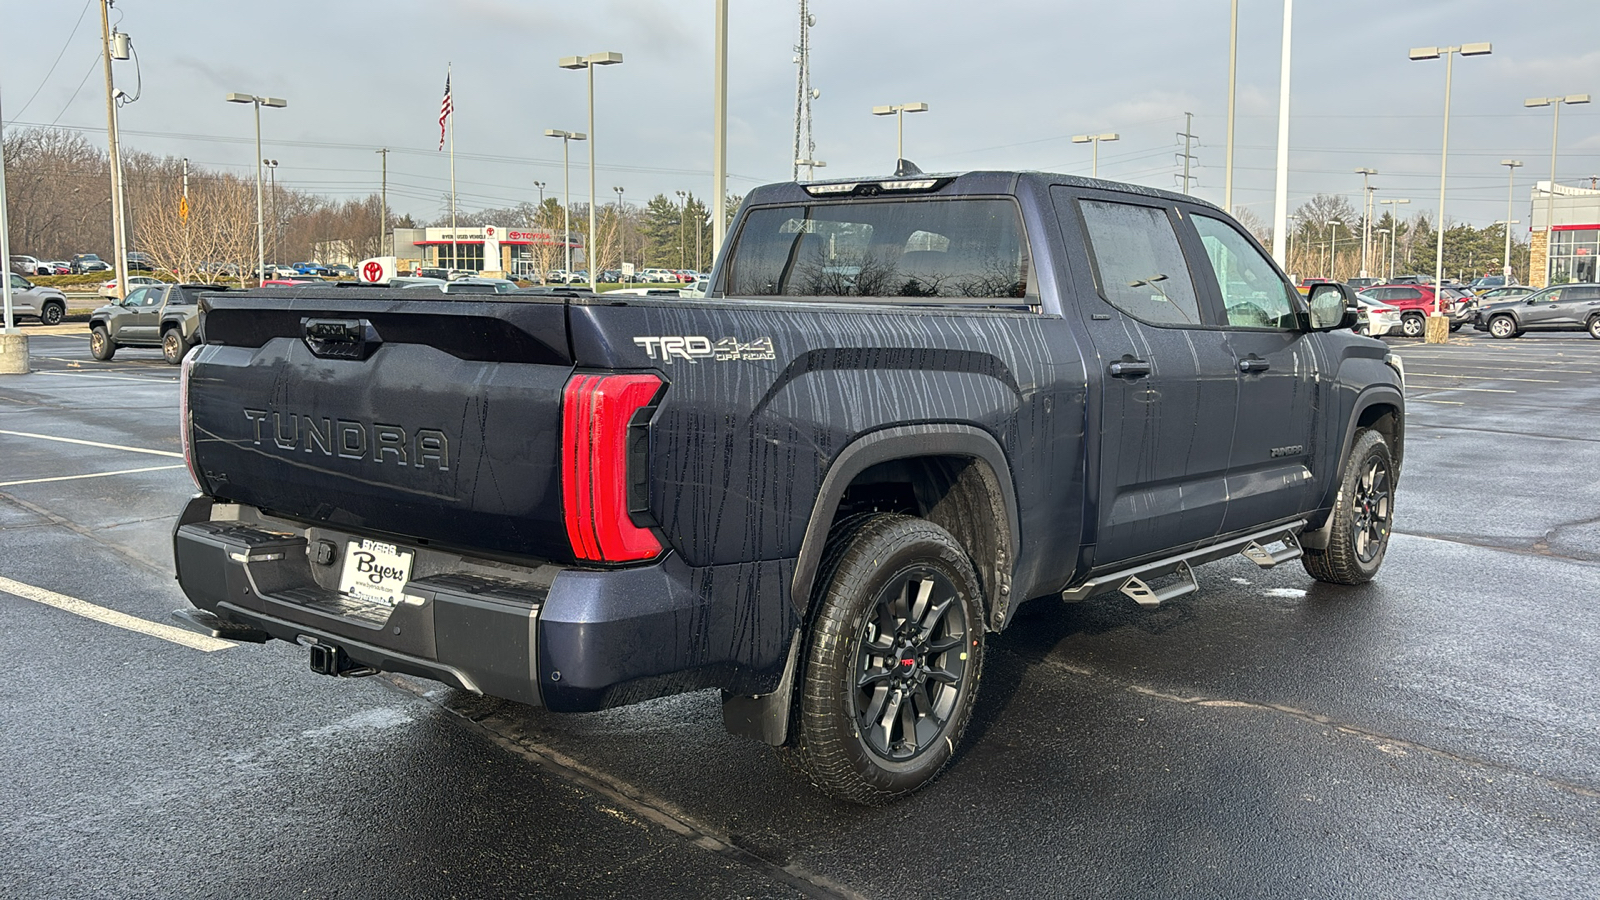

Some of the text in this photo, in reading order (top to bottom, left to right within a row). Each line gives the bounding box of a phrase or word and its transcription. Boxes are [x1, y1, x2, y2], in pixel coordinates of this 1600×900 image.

[633, 336, 716, 364] TRD
[716, 353, 740, 361] OFF
[243, 407, 449, 471] TUNDRA
[1271, 445, 1302, 457] TUNDRA
[363, 539, 397, 556] BYERS
[353, 551, 403, 584] Byers
[901, 658, 915, 667] TRD
